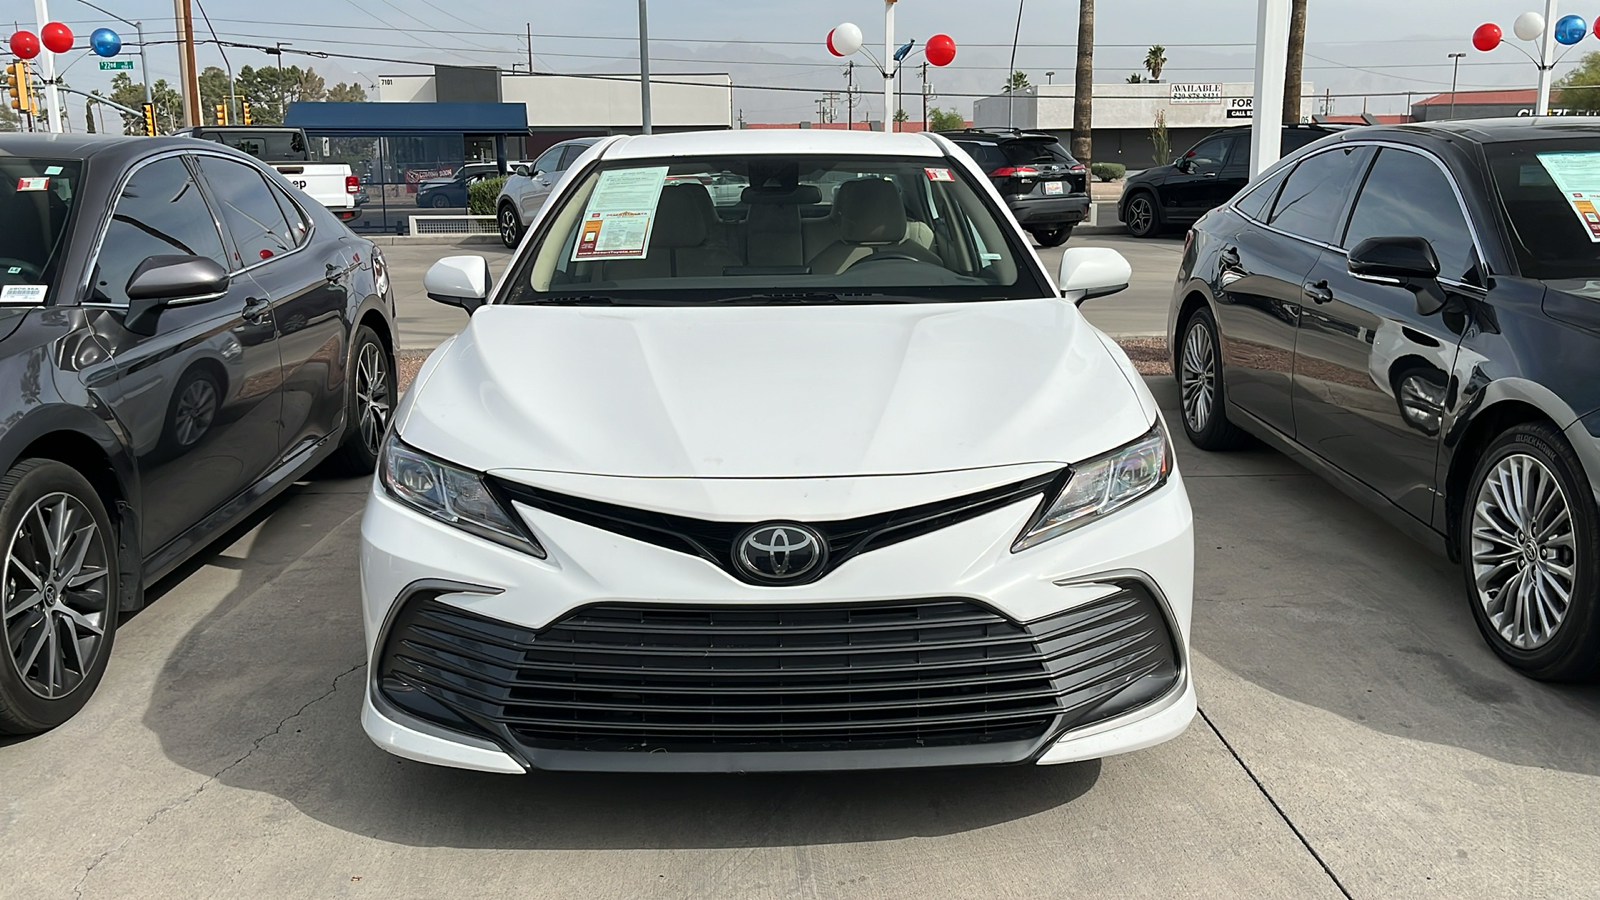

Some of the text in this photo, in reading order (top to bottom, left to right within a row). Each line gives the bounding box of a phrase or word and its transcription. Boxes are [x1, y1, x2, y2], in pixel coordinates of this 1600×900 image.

[1232, 99, 1252, 107] FOR
[439, 168, 452, 177] SOON
[1515, 434, 1557, 462] BLACKHAWK
